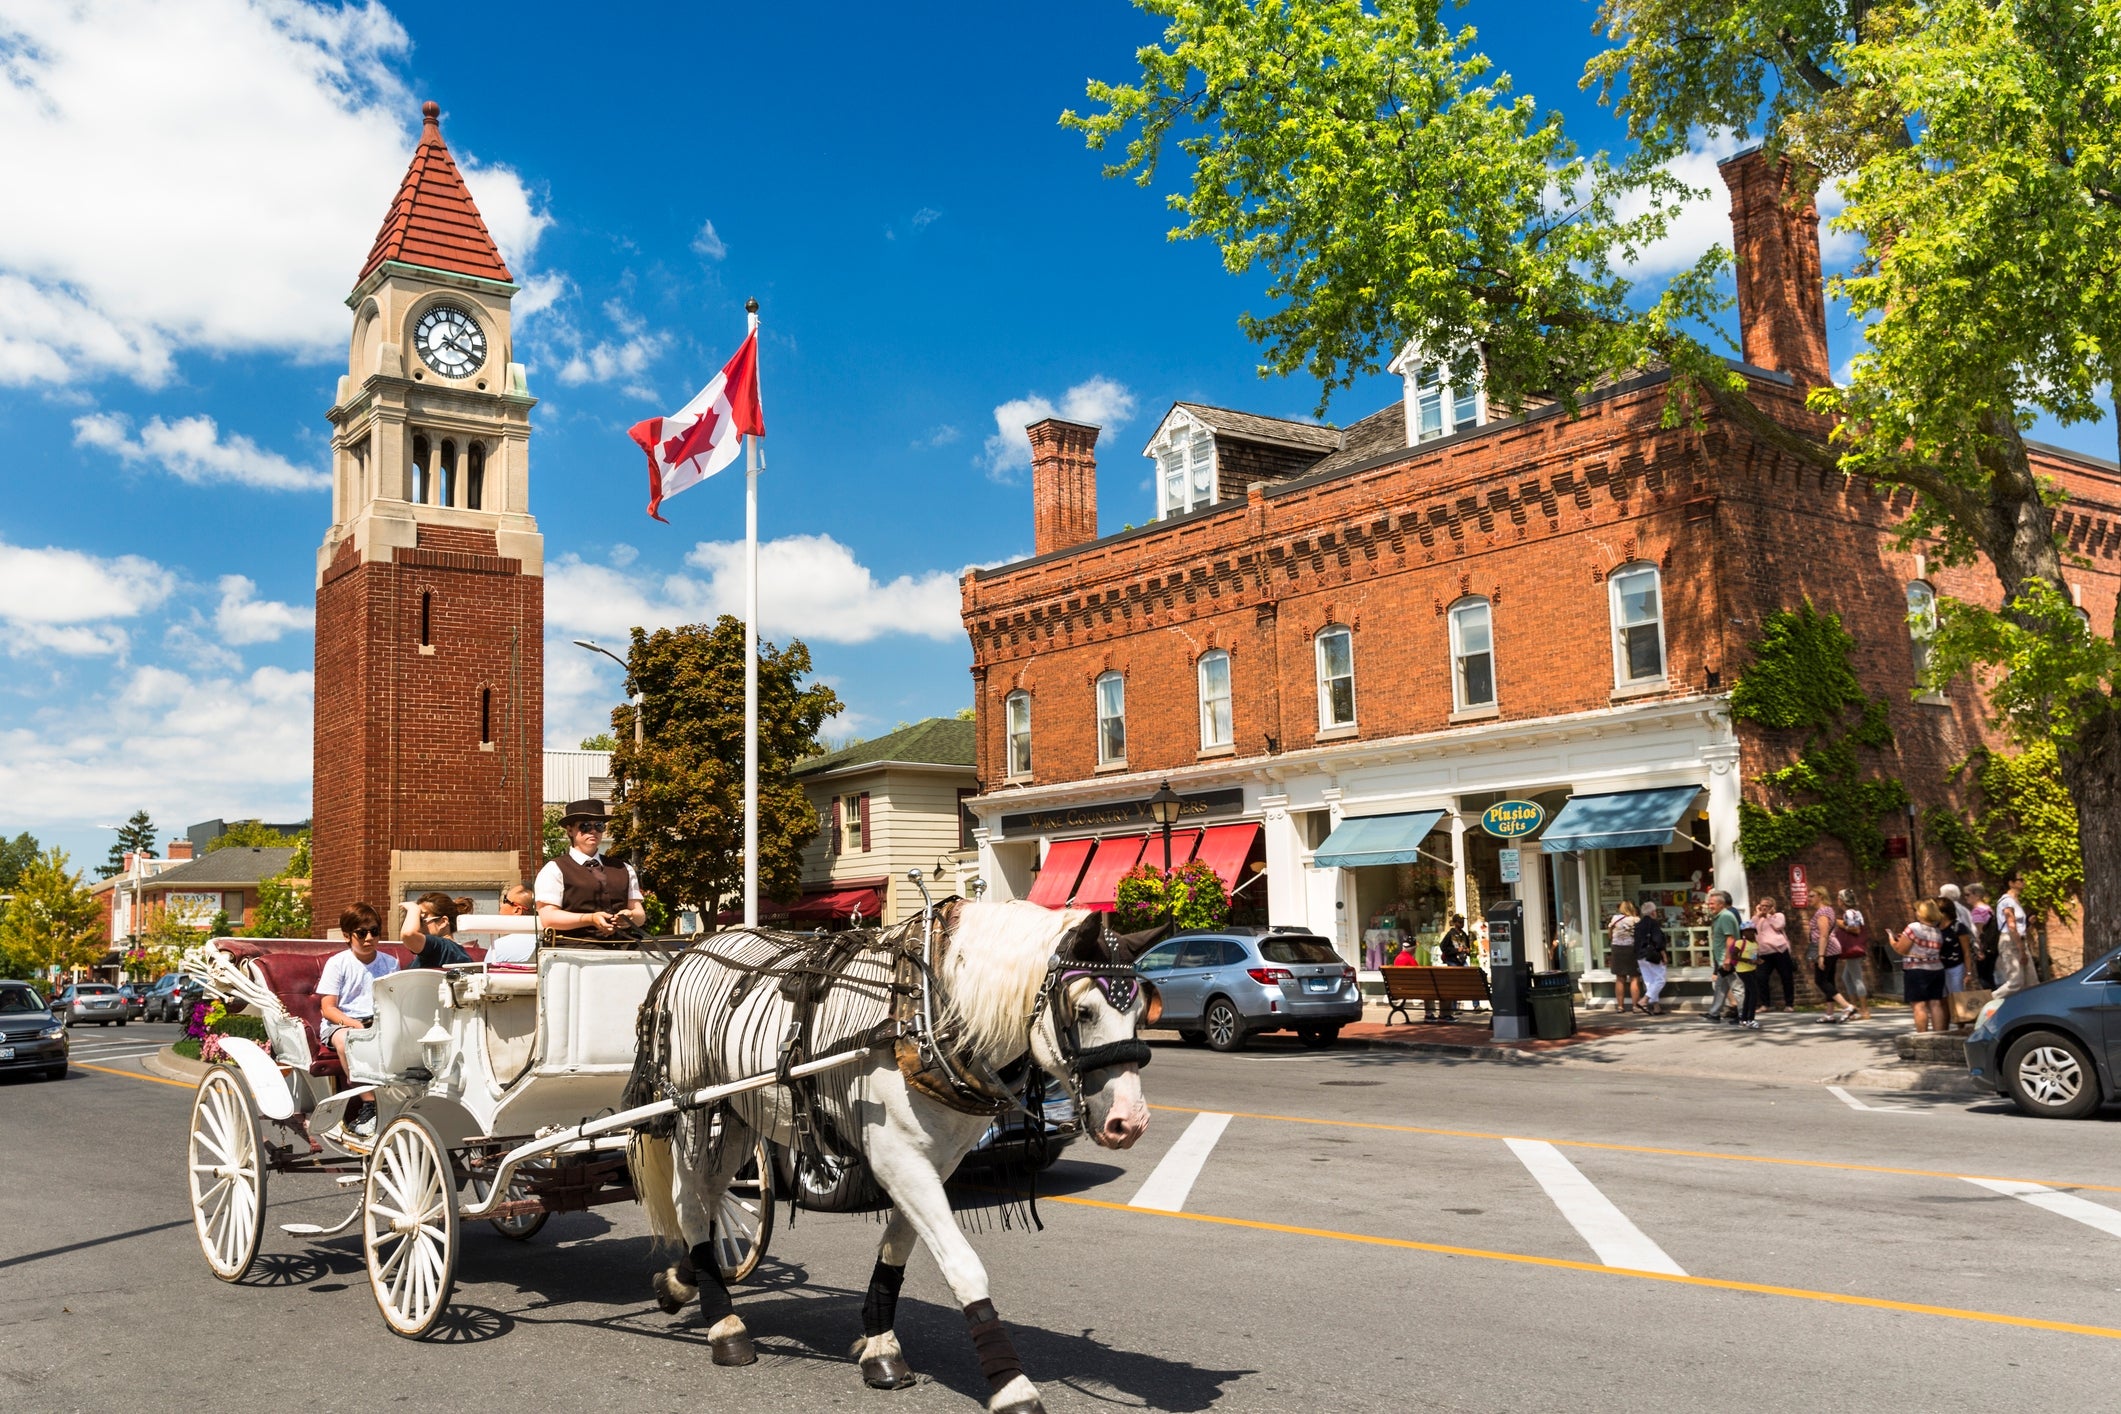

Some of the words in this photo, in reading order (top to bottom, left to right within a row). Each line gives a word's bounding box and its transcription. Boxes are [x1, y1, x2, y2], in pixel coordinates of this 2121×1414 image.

[1066, 807, 1130, 827] COUNTRY
[1490, 806, 1536, 822] Plusios
[1499, 820, 1526, 835] Gifts
